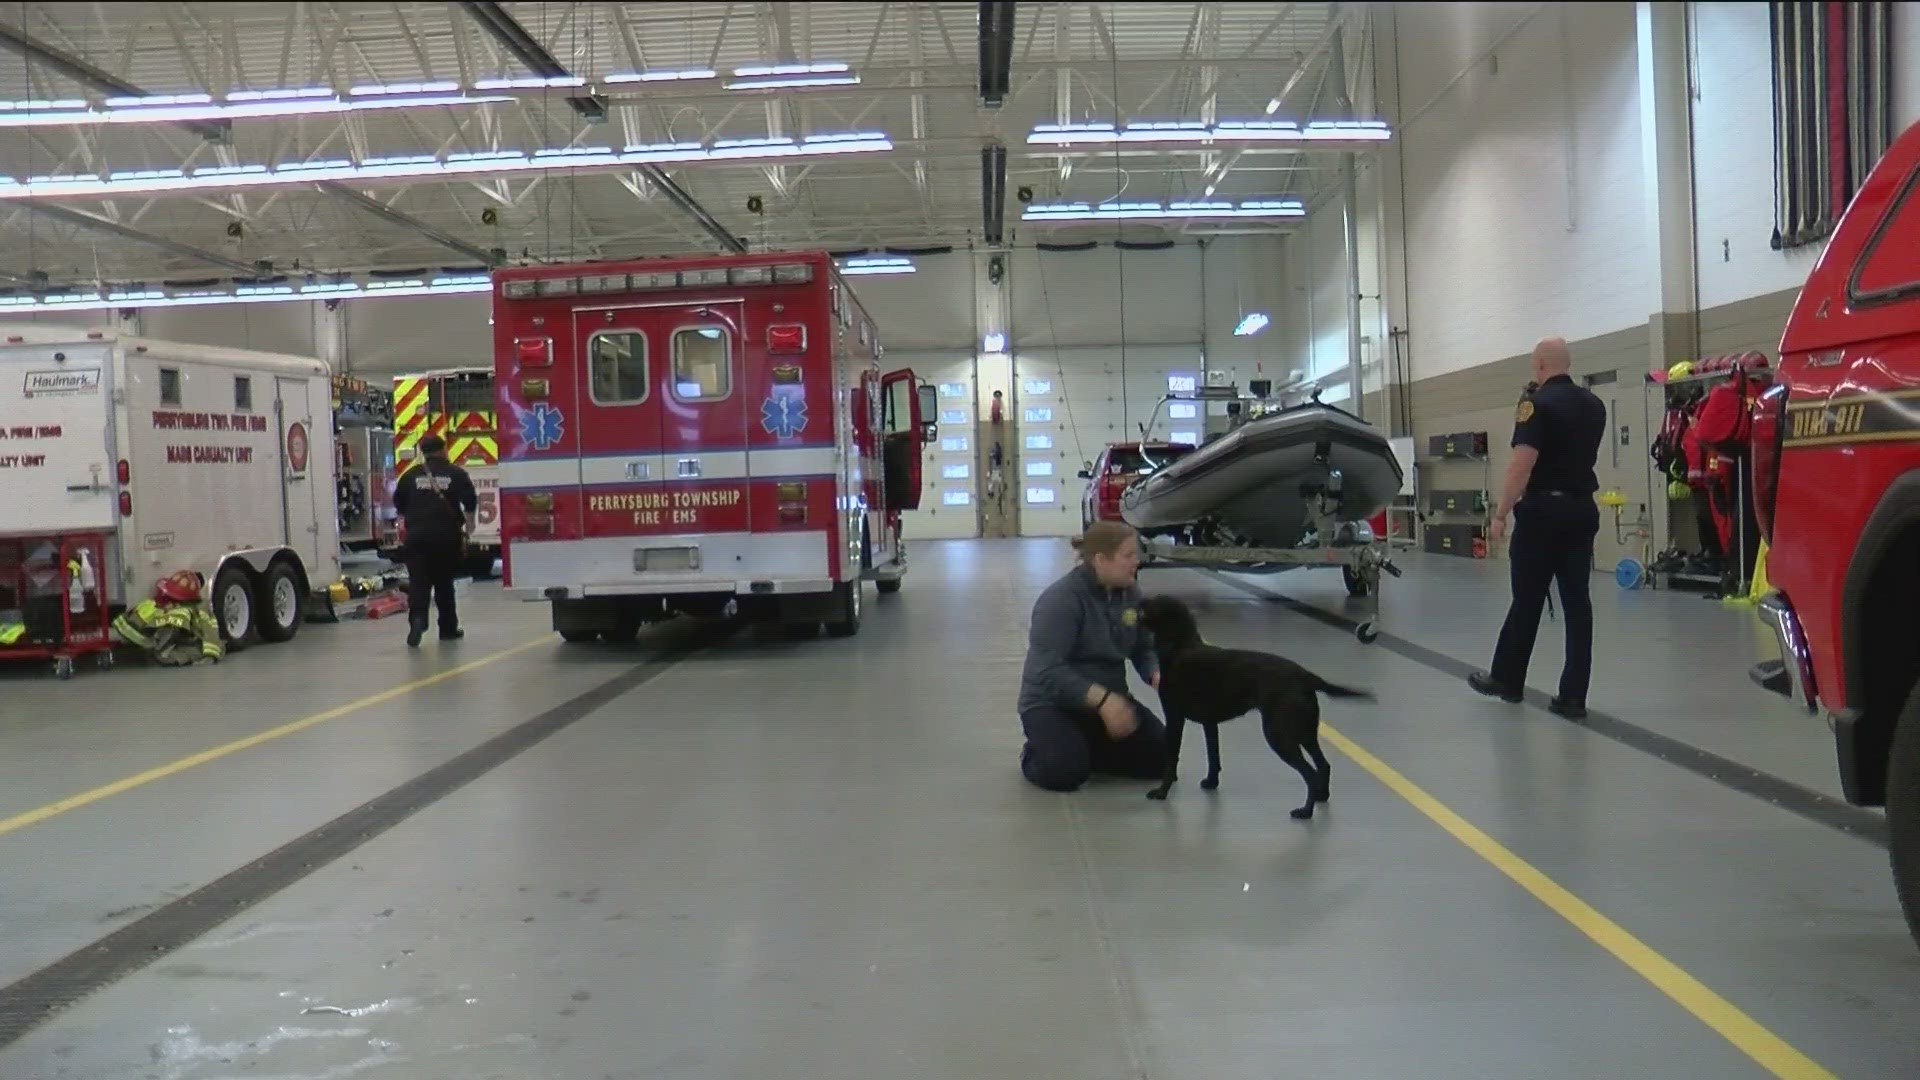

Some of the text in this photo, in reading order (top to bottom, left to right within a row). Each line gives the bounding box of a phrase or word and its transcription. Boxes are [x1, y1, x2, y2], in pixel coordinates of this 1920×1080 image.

[33, 374, 89, 388] Haulmark
[1834, 403, 1864, 434] 911
[590, 489, 740, 511] PERRYSBURG TOWNSHIP
[633, 511, 660, 525] FIRE
[672, 509, 697, 524] EMS
